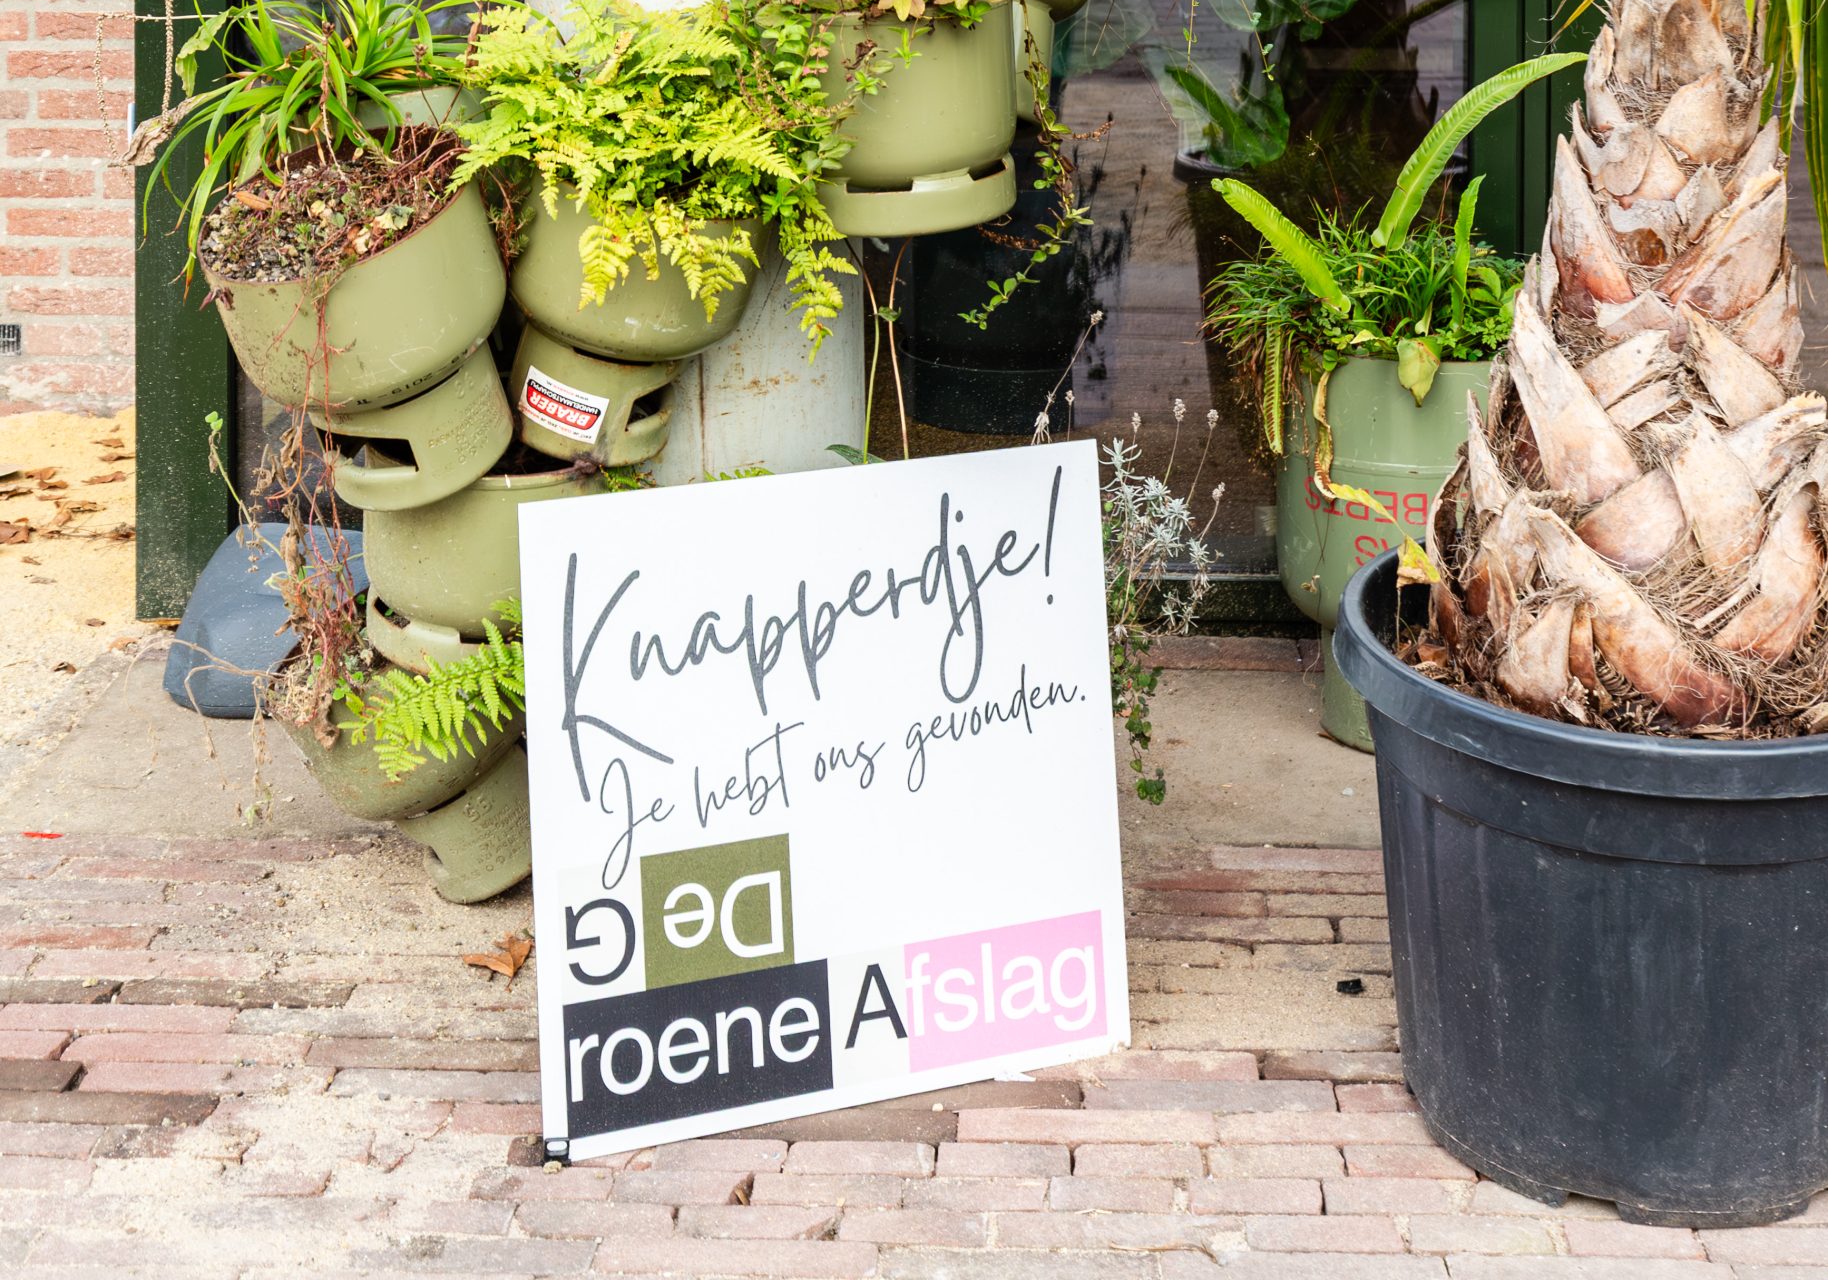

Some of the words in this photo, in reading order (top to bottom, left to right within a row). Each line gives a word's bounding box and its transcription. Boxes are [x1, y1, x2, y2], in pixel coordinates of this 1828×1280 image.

[391, 372, 433, 396] 2019
[529, 391, 591, 427] BRABER
[562, 465, 1063, 803] Knapperdje!
[599, 757, 676, 890] Je
[694, 722, 805, 828] hebt
[814, 737, 887, 790] ons
[905, 663, 1087, 793] gevonden.
[662, 870, 785, 959] De
[568, 996, 821, 1104] roene
[844, 942, 1097, 1050] Afslag
